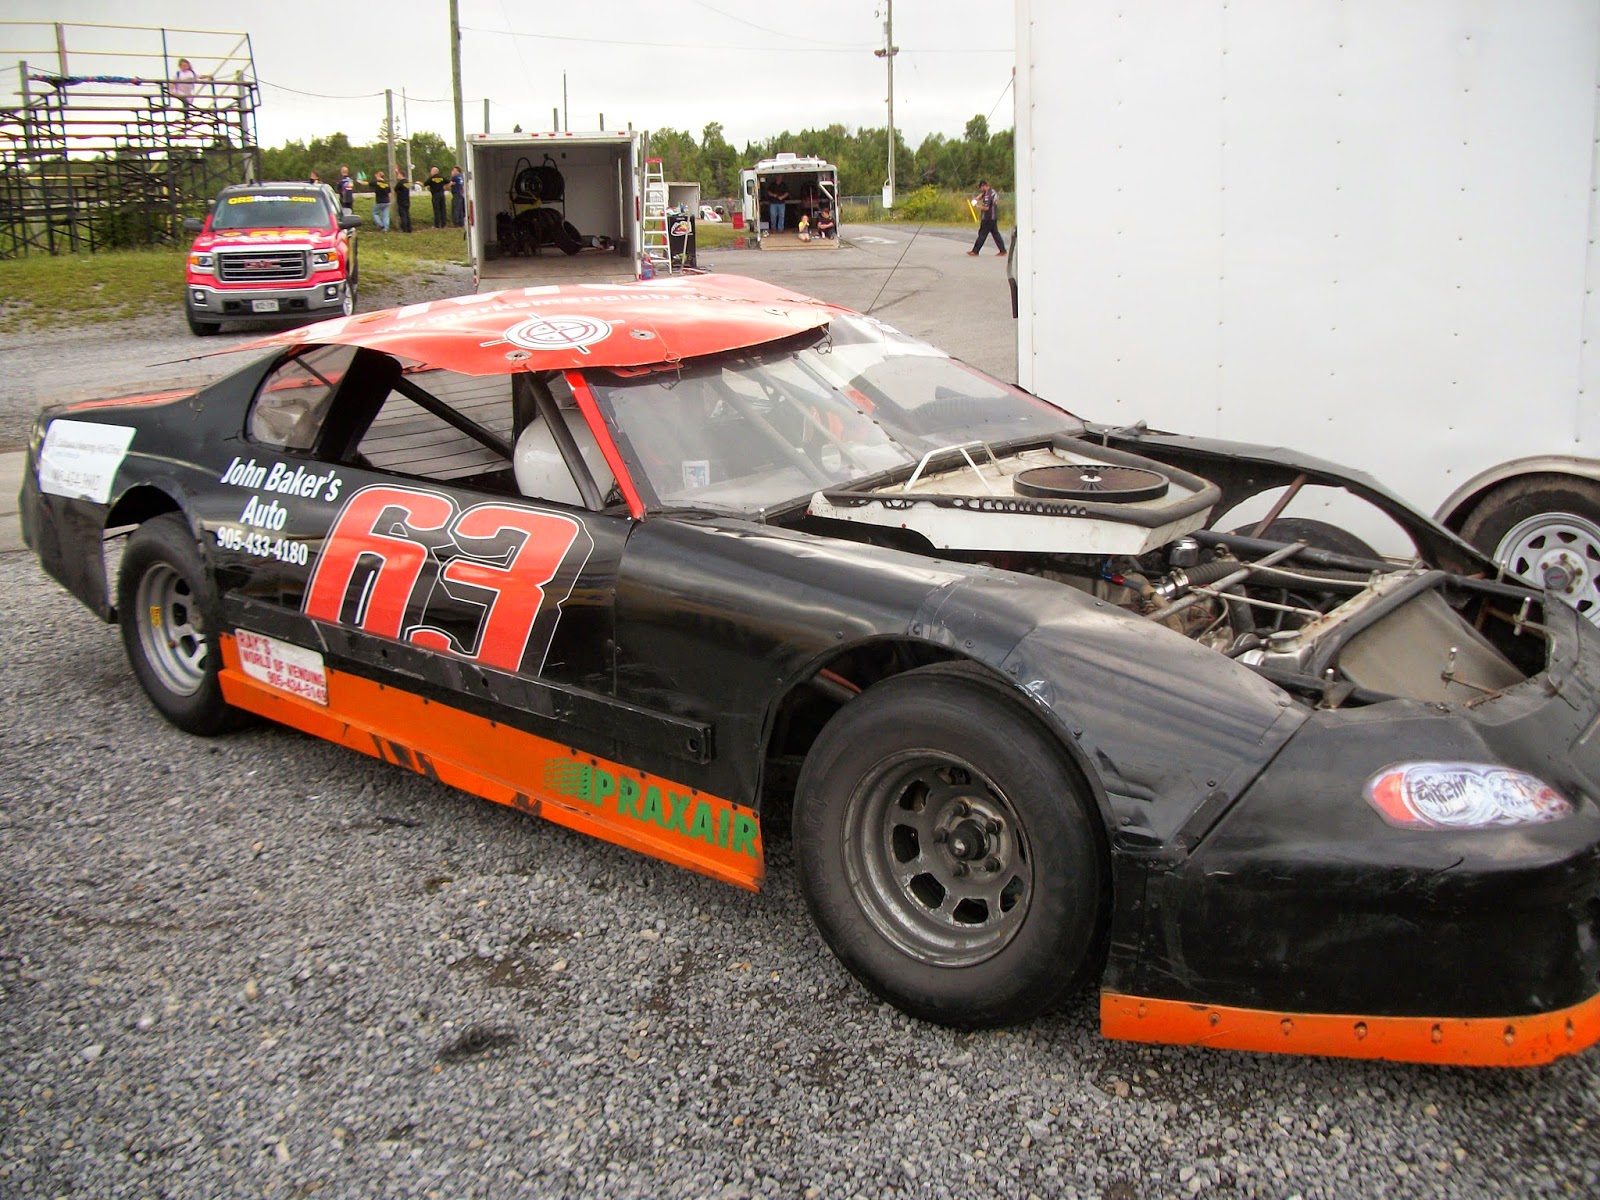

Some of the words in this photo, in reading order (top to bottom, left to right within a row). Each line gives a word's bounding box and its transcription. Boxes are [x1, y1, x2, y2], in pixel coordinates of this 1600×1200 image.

[220, 456, 268, 489] John
[263, 462, 343, 502] Baker's
[240, 495, 288, 531] Auto
[216, 526, 309, 566] 905-433-4180
[302, 484, 594, 678] 63
[242, 651, 271, 669] WORLD
[273, 659, 284, 673] OF
[286, 663, 326, 688] VENDING
[593, 767, 759, 859] PRAXAIR
